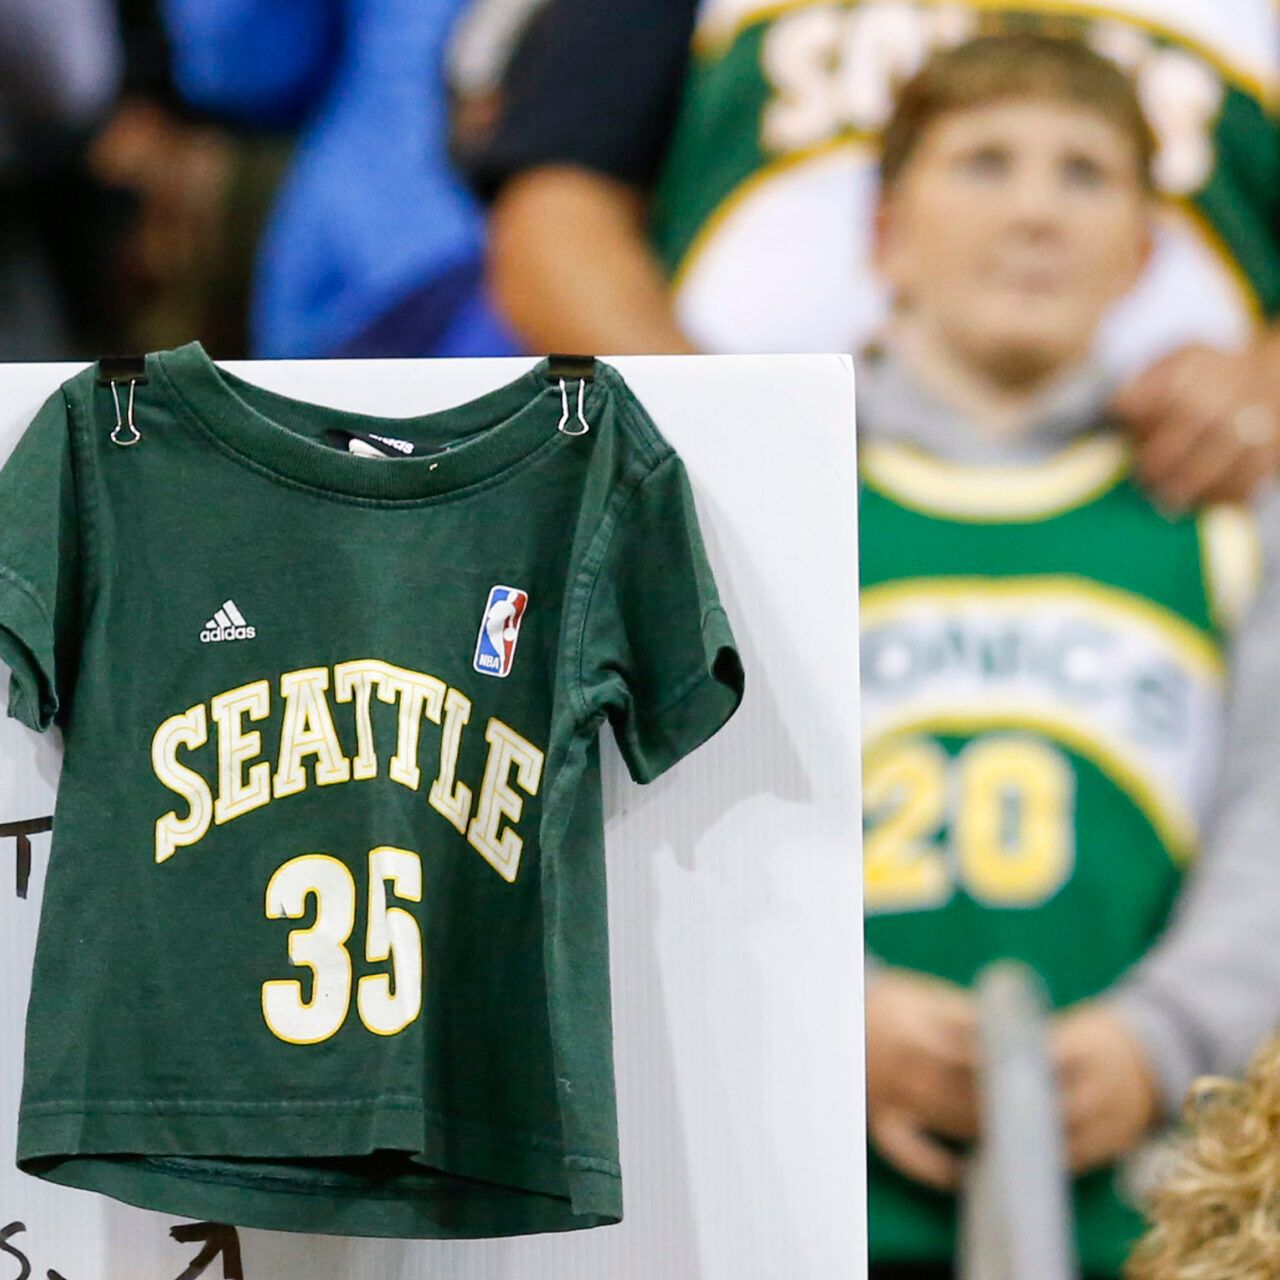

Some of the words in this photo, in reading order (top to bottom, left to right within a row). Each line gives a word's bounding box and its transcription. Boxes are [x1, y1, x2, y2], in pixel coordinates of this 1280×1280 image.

[200, 625, 257, 643] adidas
[478, 653, 500, 670] NBA
[151, 658, 545, 884] SEATTLE
[862, 732, 1077, 912] 20
[261, 845, 422, 1045] 35
